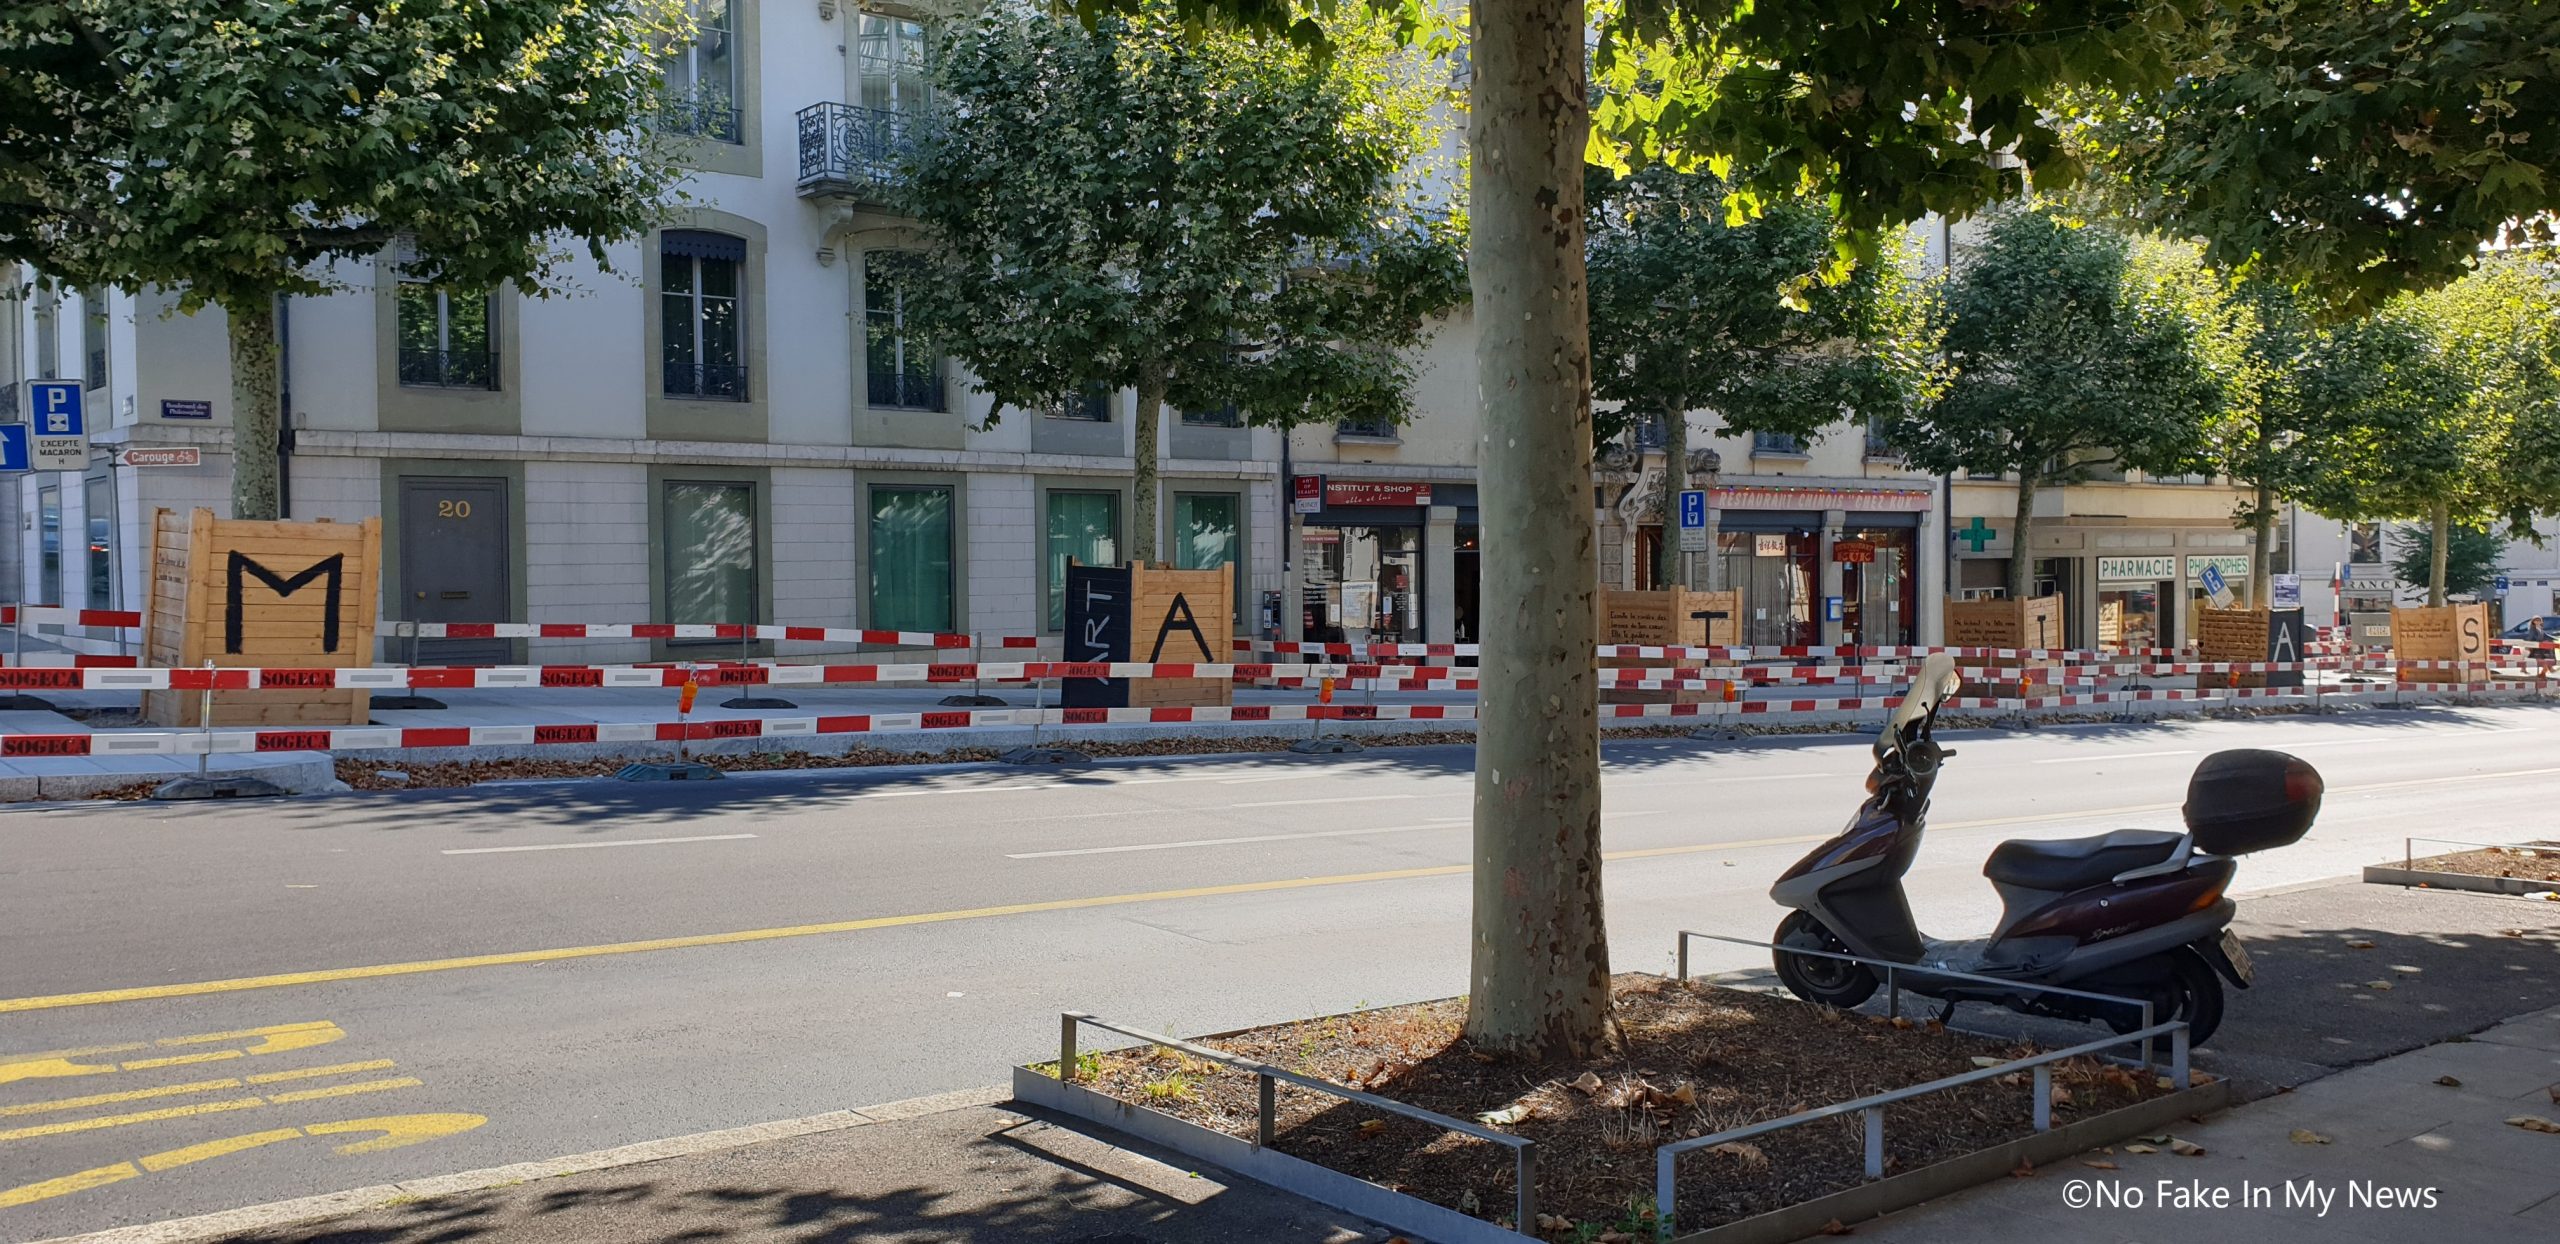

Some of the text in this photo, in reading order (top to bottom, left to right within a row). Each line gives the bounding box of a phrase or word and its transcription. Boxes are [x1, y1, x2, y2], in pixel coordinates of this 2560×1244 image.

[48, 388, 67, 412] P
[39, 448, 82, 456] MACARON
[131, 451, 175, 464] Carouge
[1327, 484, 1373, 492] NSTITUT
[1383, 485, 1413, 493] SHOP
[1345, 496, 1362, 504] elle
[1378, 493, 1392, 501] lui
[1688, 494, 1698, 512] P
[1719, 491, 1793, 507] RESTAURANT
[1798, 493, 1844, 508] CHINOIS
[438, 499, 472, 518] 20
[1837, 552, 1872, 562] KUK
[2102, 559, 2173, 577] PHARMACIE
[2205, 570, 2214, 582] P
[226, 549, 343, 654] M
[1148, 592, 1214, 664] A
[2463, 617, 2480, 654] S
[1690, 610, 1729, 667] T
[2273, 622, 2296, 662] A
[261, 671, 332, 686] SOGECA
[541, 671, 601, 686] SOGECA
[720, 668, 767, 683] OGECA
[928, 665, 977, 677] SOGECA
[1234, 666, 1272, 676] SOGECA
[0, 672, 80, 687] SOGECA
[923, 713, 970, 727] SOGECA
[1064, 710, 1108, 722] SOGECA
[1232, 707, 1269, 718] SOGECA
[536, 727, 597, 740] SOGECA
[714, 722, 762, 736] OGECA
[4, 738, 88, 754] SOGECA
[257, 734, 330, 750] SOGECA
